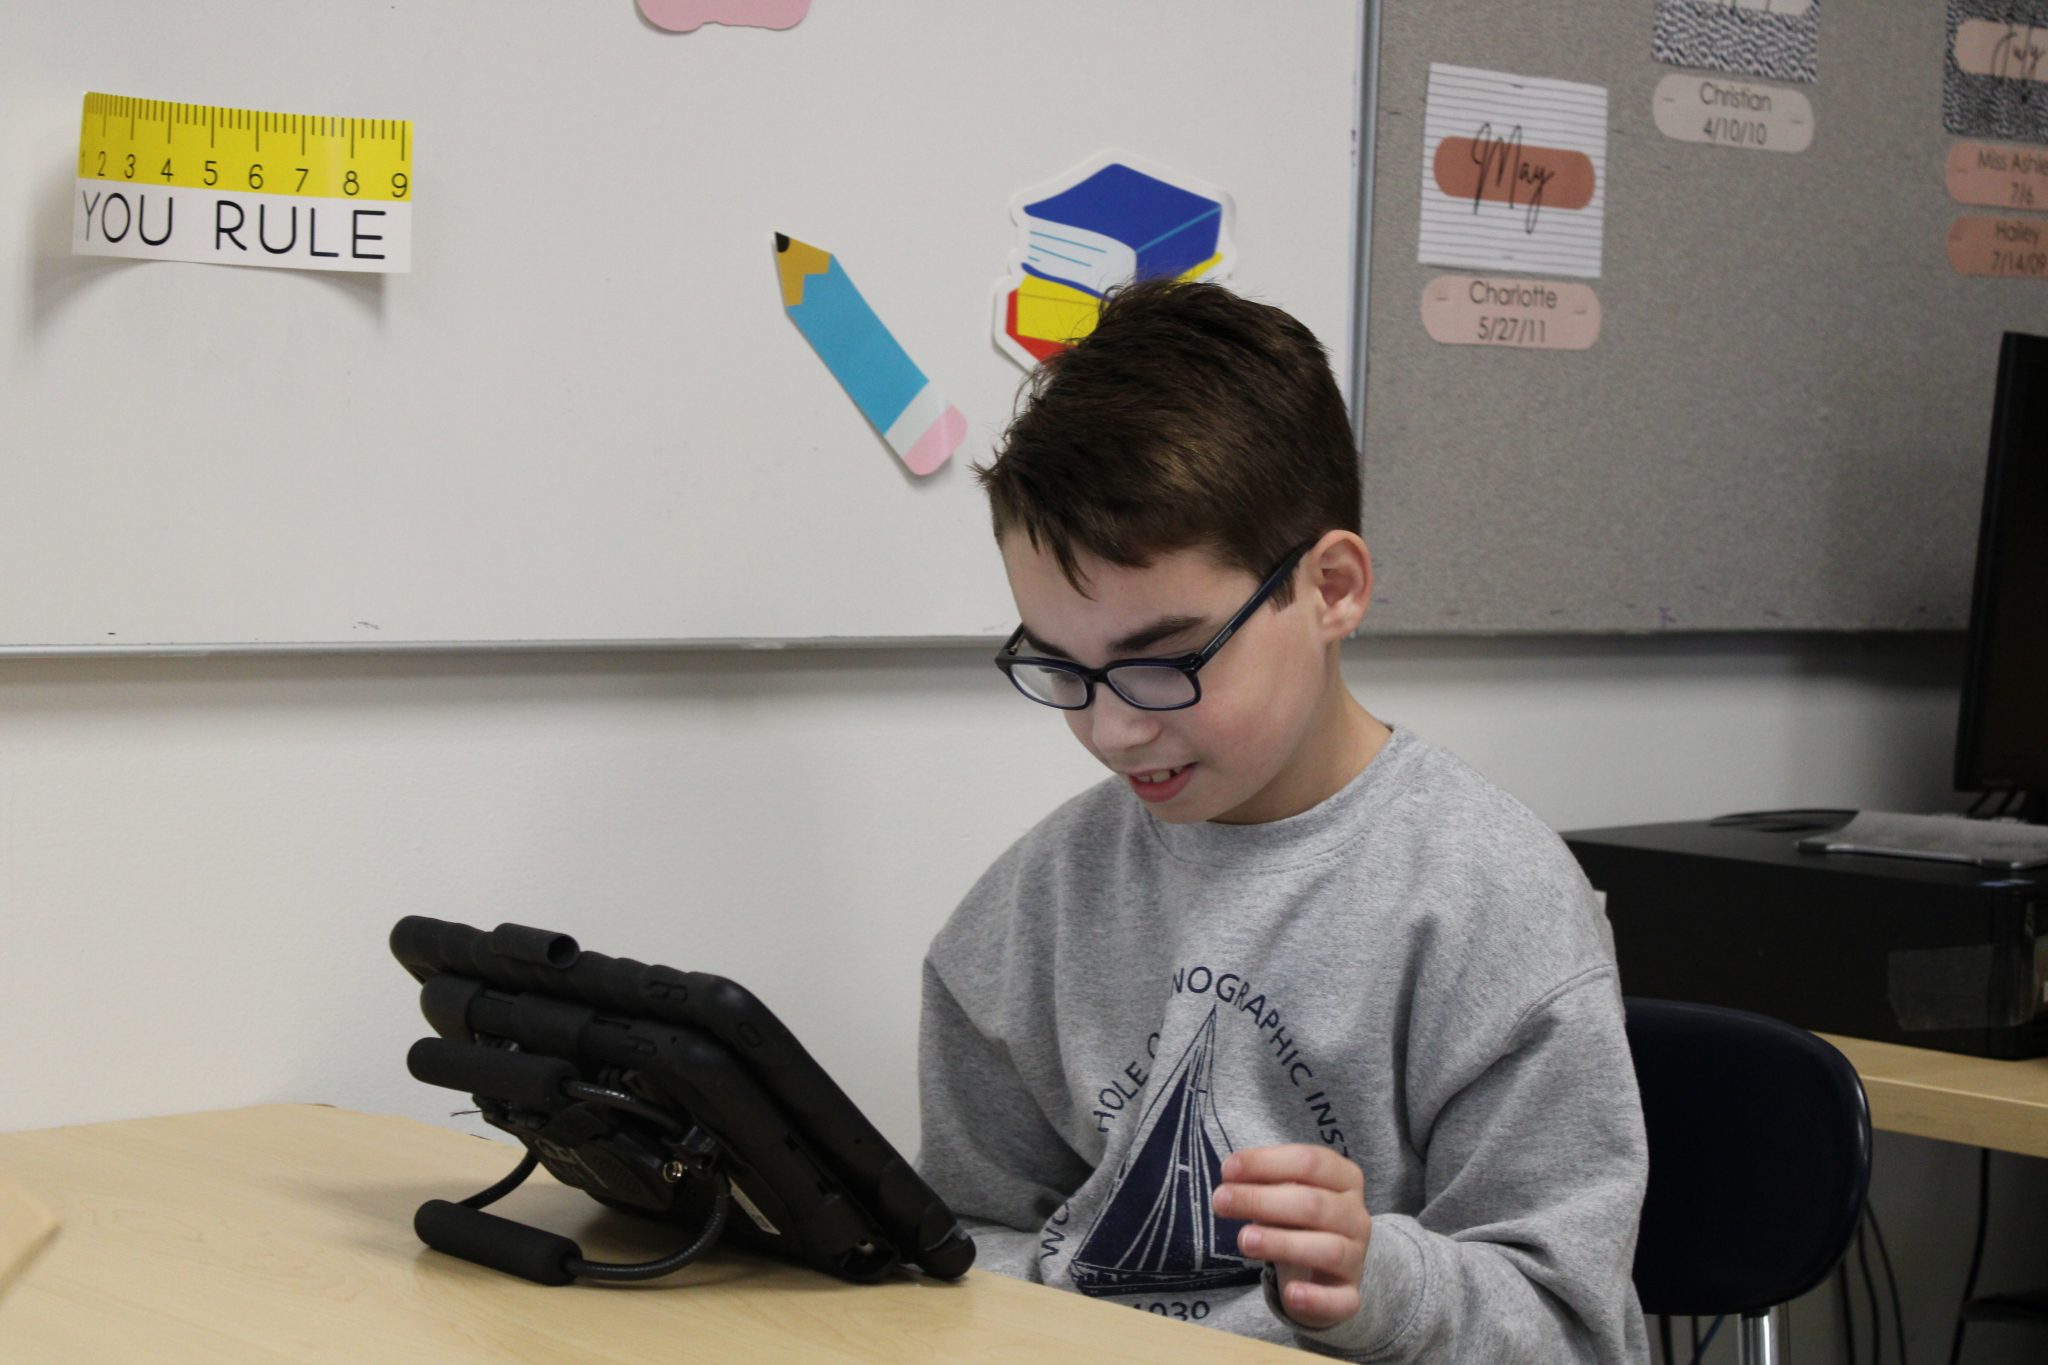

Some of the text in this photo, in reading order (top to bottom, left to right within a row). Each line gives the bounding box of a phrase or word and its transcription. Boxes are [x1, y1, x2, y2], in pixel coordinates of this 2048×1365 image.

[1701, 82, 1772, 112] Christian
[1703, 118, 1767, 145] 4/10/10
[97, 151, 106, 176] 2
[124, 154, 136, 179] 3
[160, 158, 174, 182] 4
[203, 160, 218, 186] 5
[248, 164, 264, 189] 6
[295, 168, 309, 192] 7
[343, 170, 360, 196] 8
[391, 172, 408, 198] 9
[1472, 122, 1555, 234] May
[82, 190, 386, 260] YOU RULE
[1469, 280, 1557, 309] Charlotte
[1477, 316, 1546, 343] 5/27/11
[1093, 1060, 1149, 1133] HOLE
